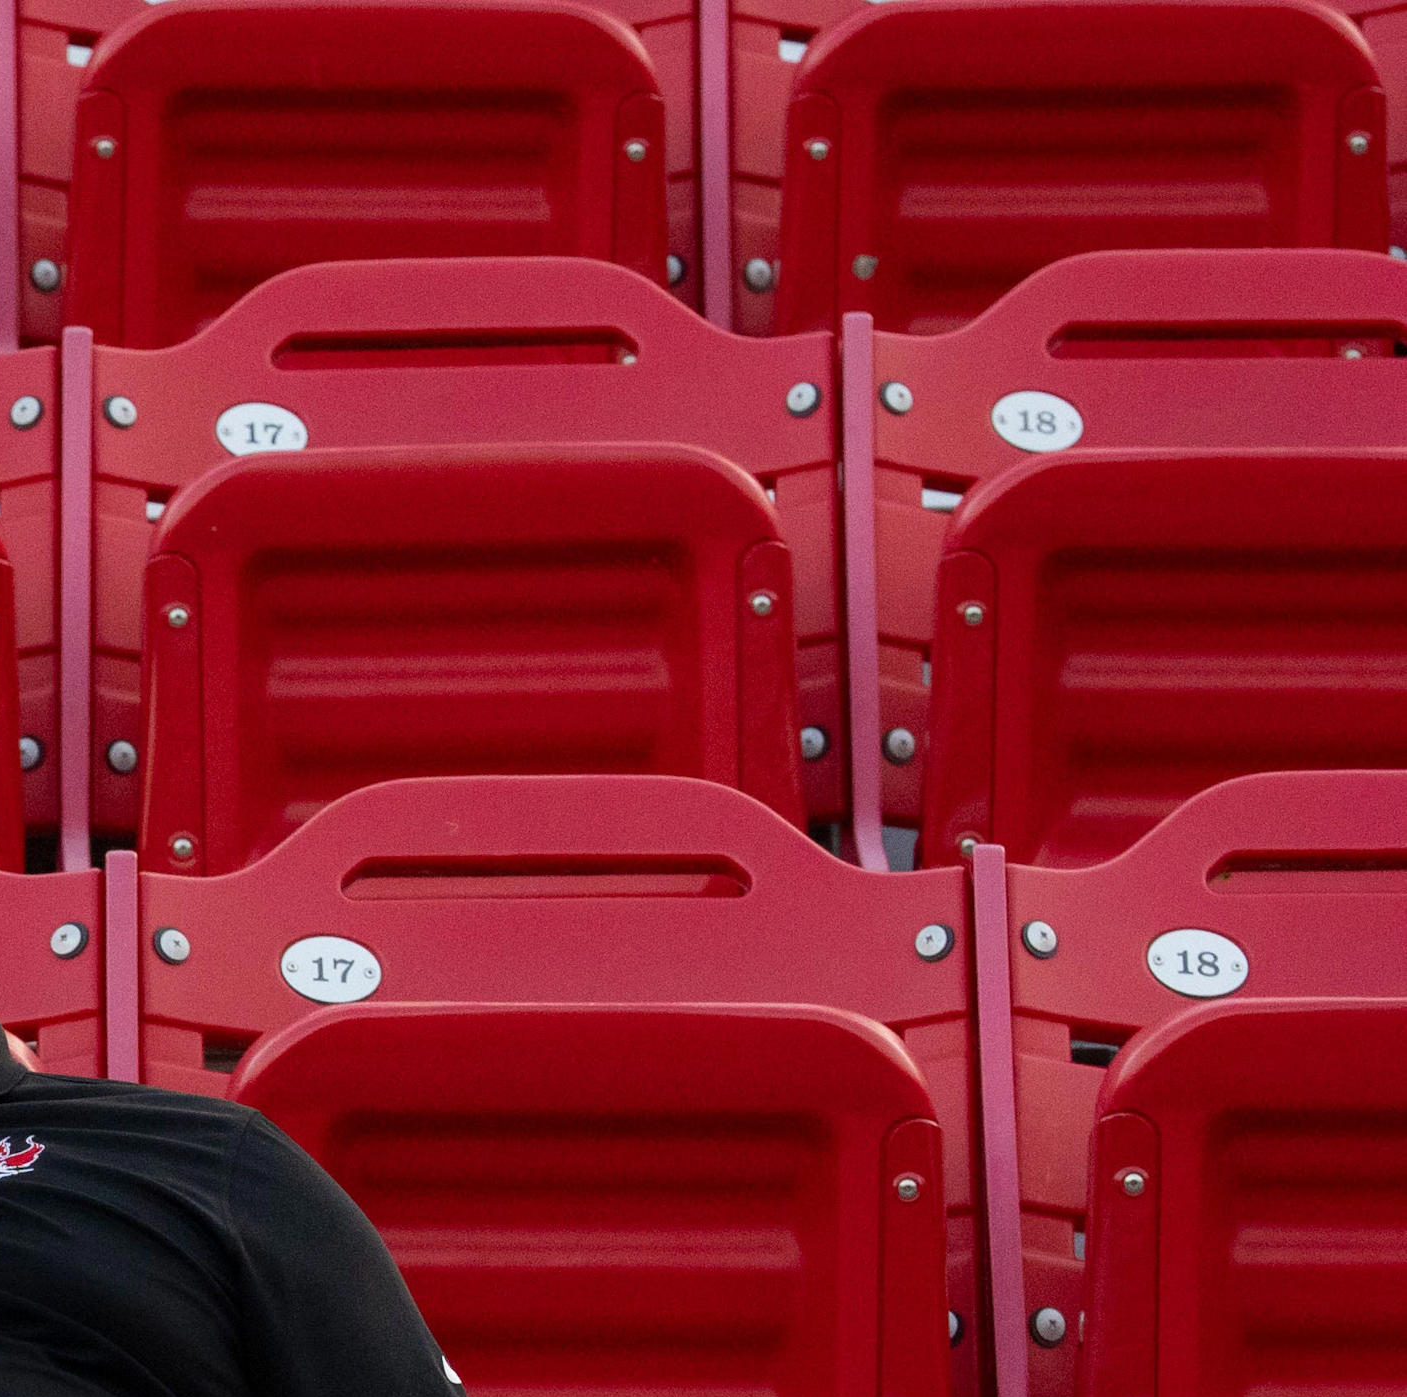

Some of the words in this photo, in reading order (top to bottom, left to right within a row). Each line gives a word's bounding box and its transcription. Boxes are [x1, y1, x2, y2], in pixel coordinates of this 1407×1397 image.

[245, 422, 284, 446] 17
[1019, 410, 1058, 435] 18
[311, 956, 356, 984] 17
[1177, 949, 1221, 978] 18
